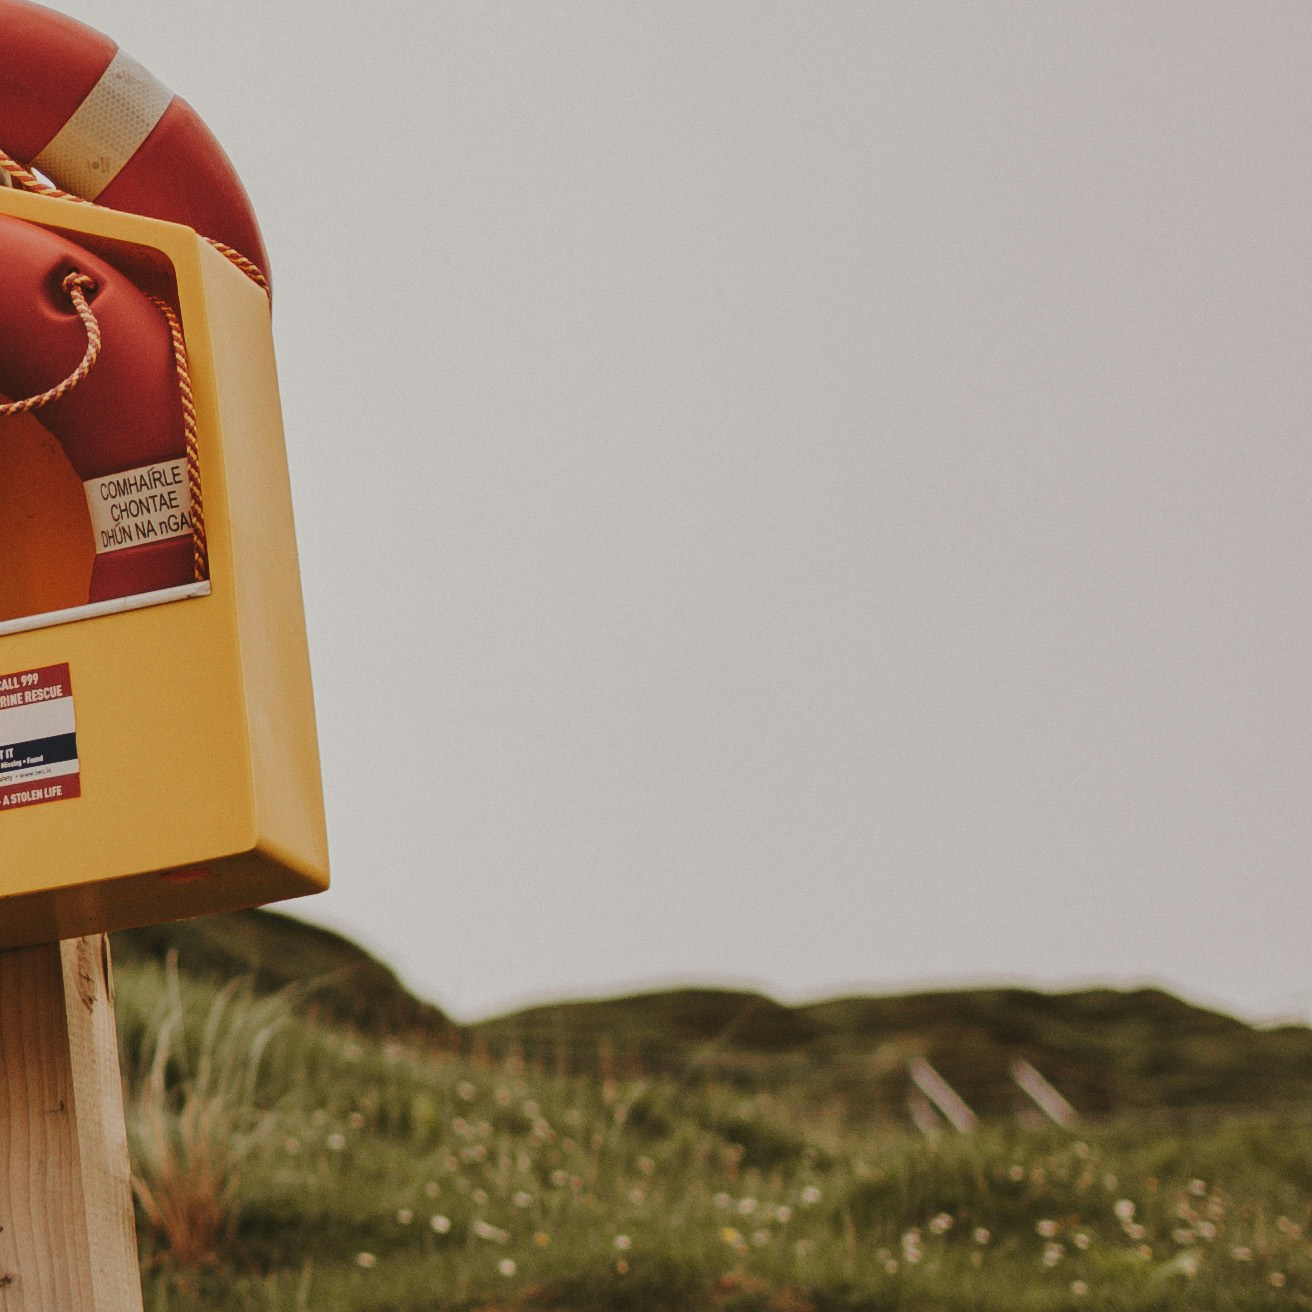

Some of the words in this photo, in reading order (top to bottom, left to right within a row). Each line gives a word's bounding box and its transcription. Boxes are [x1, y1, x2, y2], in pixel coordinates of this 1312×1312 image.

[101, 466, 183, 501] COMHAÍRLE
[111, 490, 179, 521] CHONTAE
[101, 522, 132, 547] DHÚN
[135, 520, 157, 540] NA
[21, 673, 39, 686] 999
[25, 684, 63, 702] RESCUE
[6, 748, 13, 758] IT
[3, 795, 11, 806] A
[10, 790, 42, 804] STOLEN
[44, 786, 62, 797] LIFE
